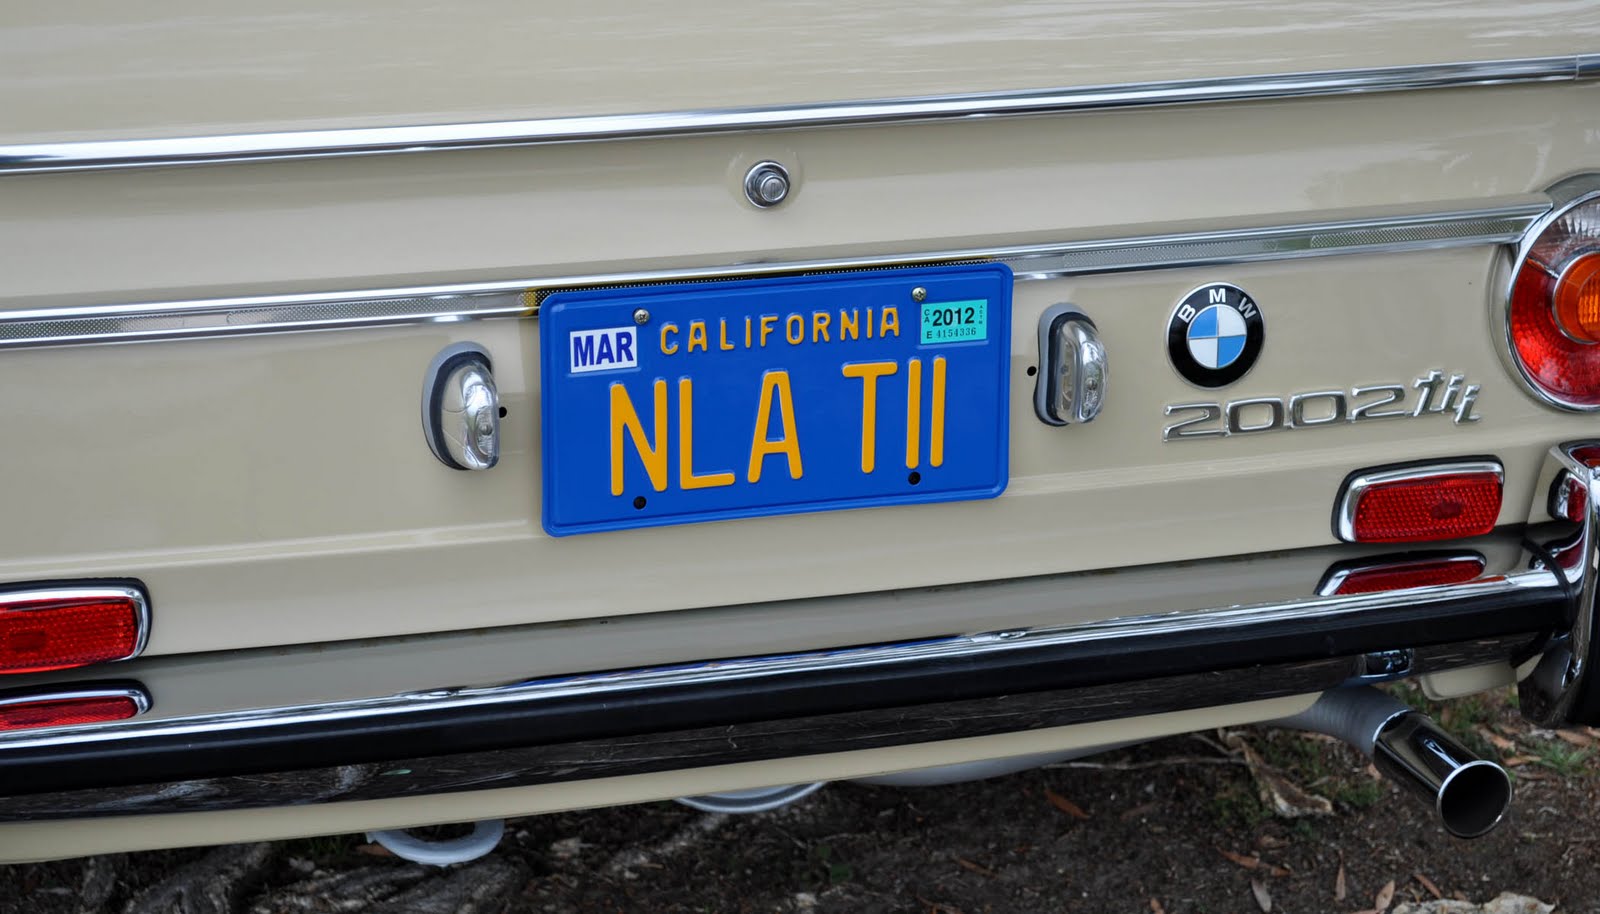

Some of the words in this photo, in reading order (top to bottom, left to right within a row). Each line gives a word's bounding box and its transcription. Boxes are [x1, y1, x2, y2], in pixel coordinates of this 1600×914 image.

[932, 307, 975, 326] 2012
[1177, 288, 1257, 323] BMW
[572, 330, 634, 369] MAR
[660, 306, 900, 355] CALIFORNIA
[609, 370, 804, 497] NLA
